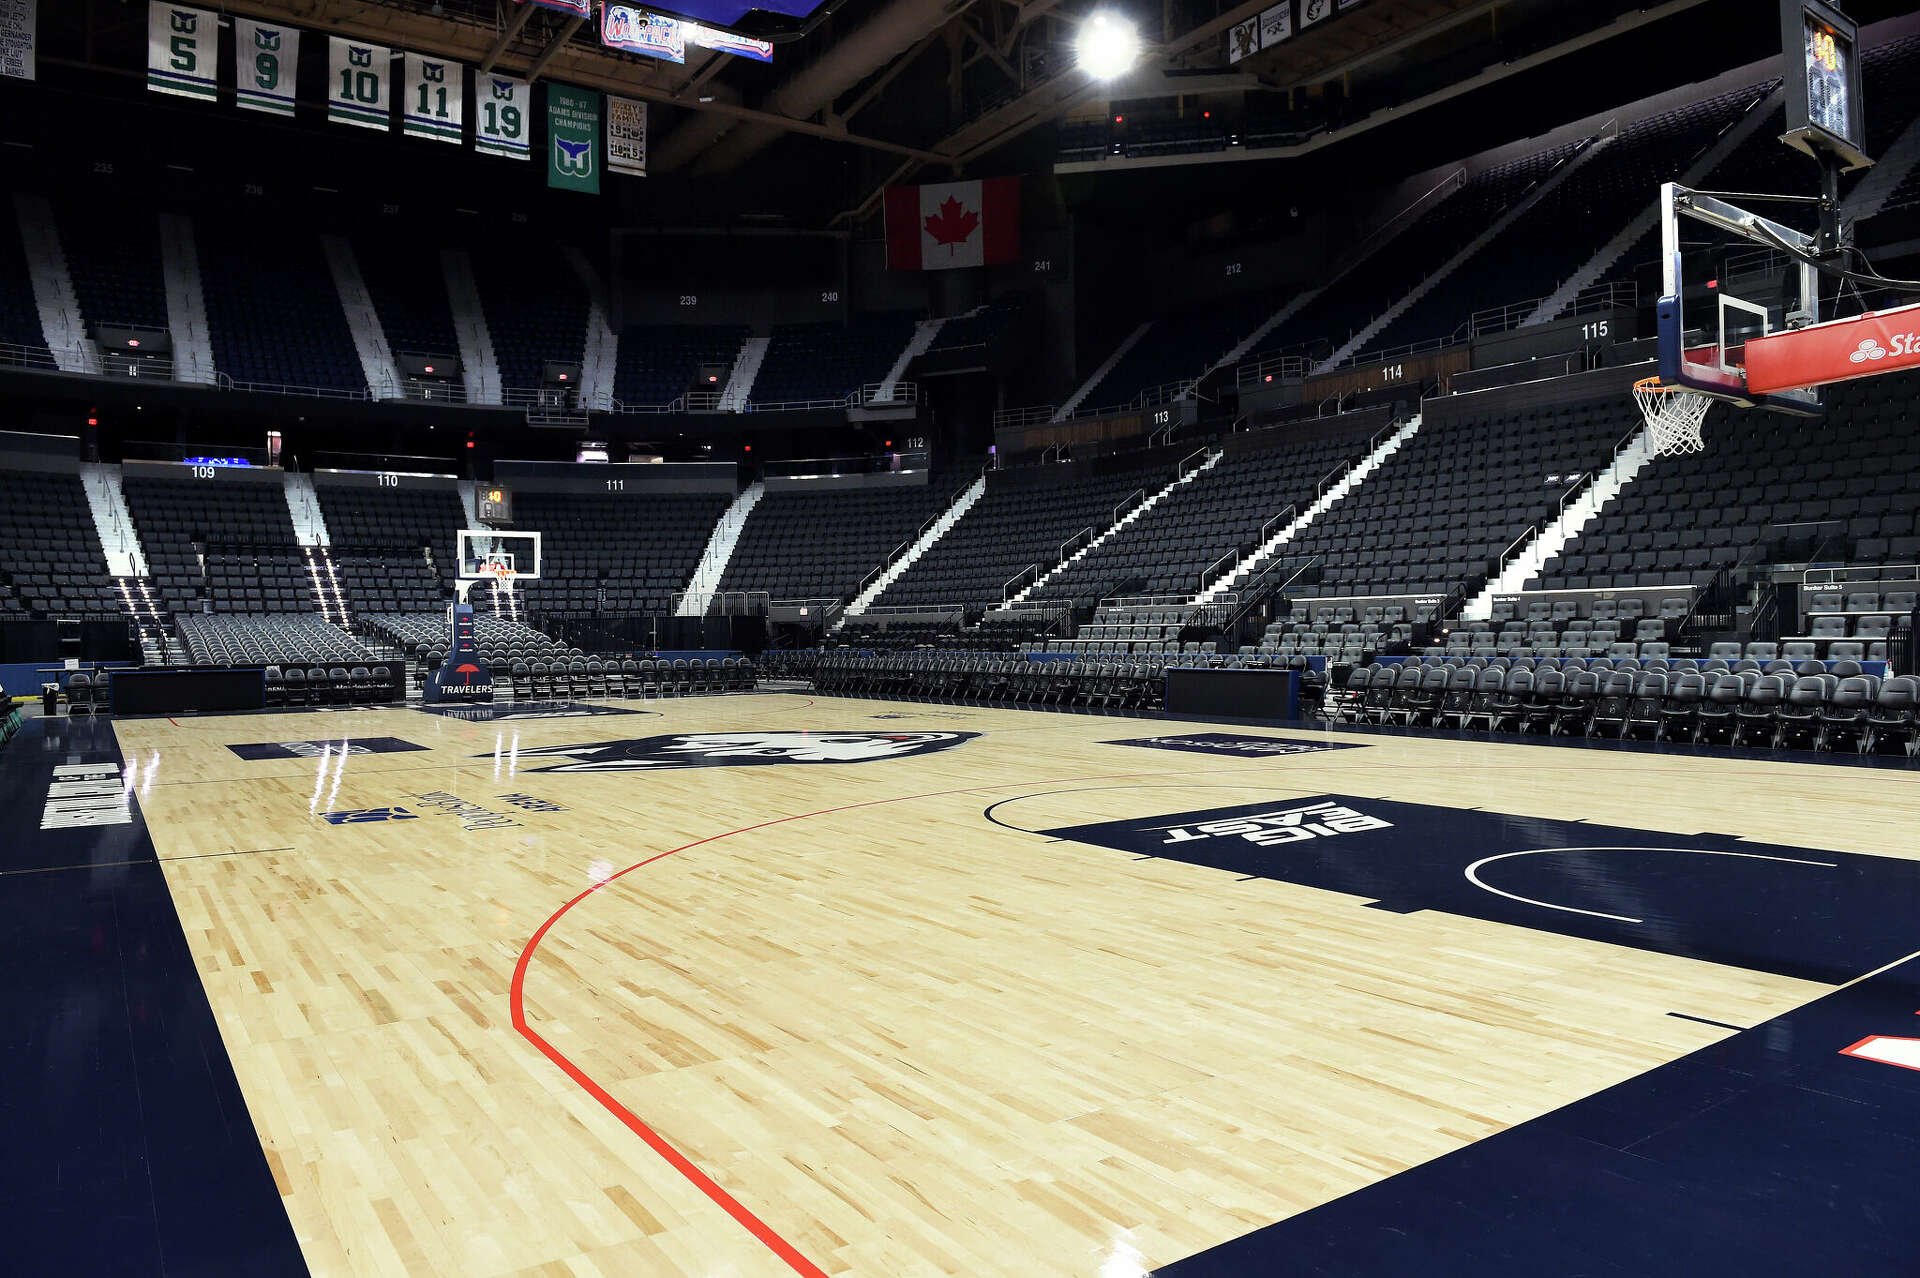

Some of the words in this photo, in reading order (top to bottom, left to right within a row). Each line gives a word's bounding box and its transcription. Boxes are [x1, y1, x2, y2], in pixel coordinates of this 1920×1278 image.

[171, 35, 197, 72] 5
[255, 54, 278, 89] 9
[340, 69, 379, 104] 10
[417, 83, 449, 118] 11
[484, 102, 522, 139] 19
[1034, 260, 1051, 271] 241
[1226, 263, 1241, 275] 212
[680, 295, 697, 306] 239
[822, 292, 838, 303] 240
[1582, 321, 1608, 340] 115
[1382, 365, 1402, 381] 114
[1154, 411, 1169, 424] 113
[907, 437, 924, 448] 112
[192, 467, 215, 478] 109
[377, 475, 398, 487] 110
[605, 480, 624, 491] 111
[441, 685, 493, 694] TRAVELERS
[1163, 805, 1364, 844] EAST
[1241, 815, 1395, 847] BIG
